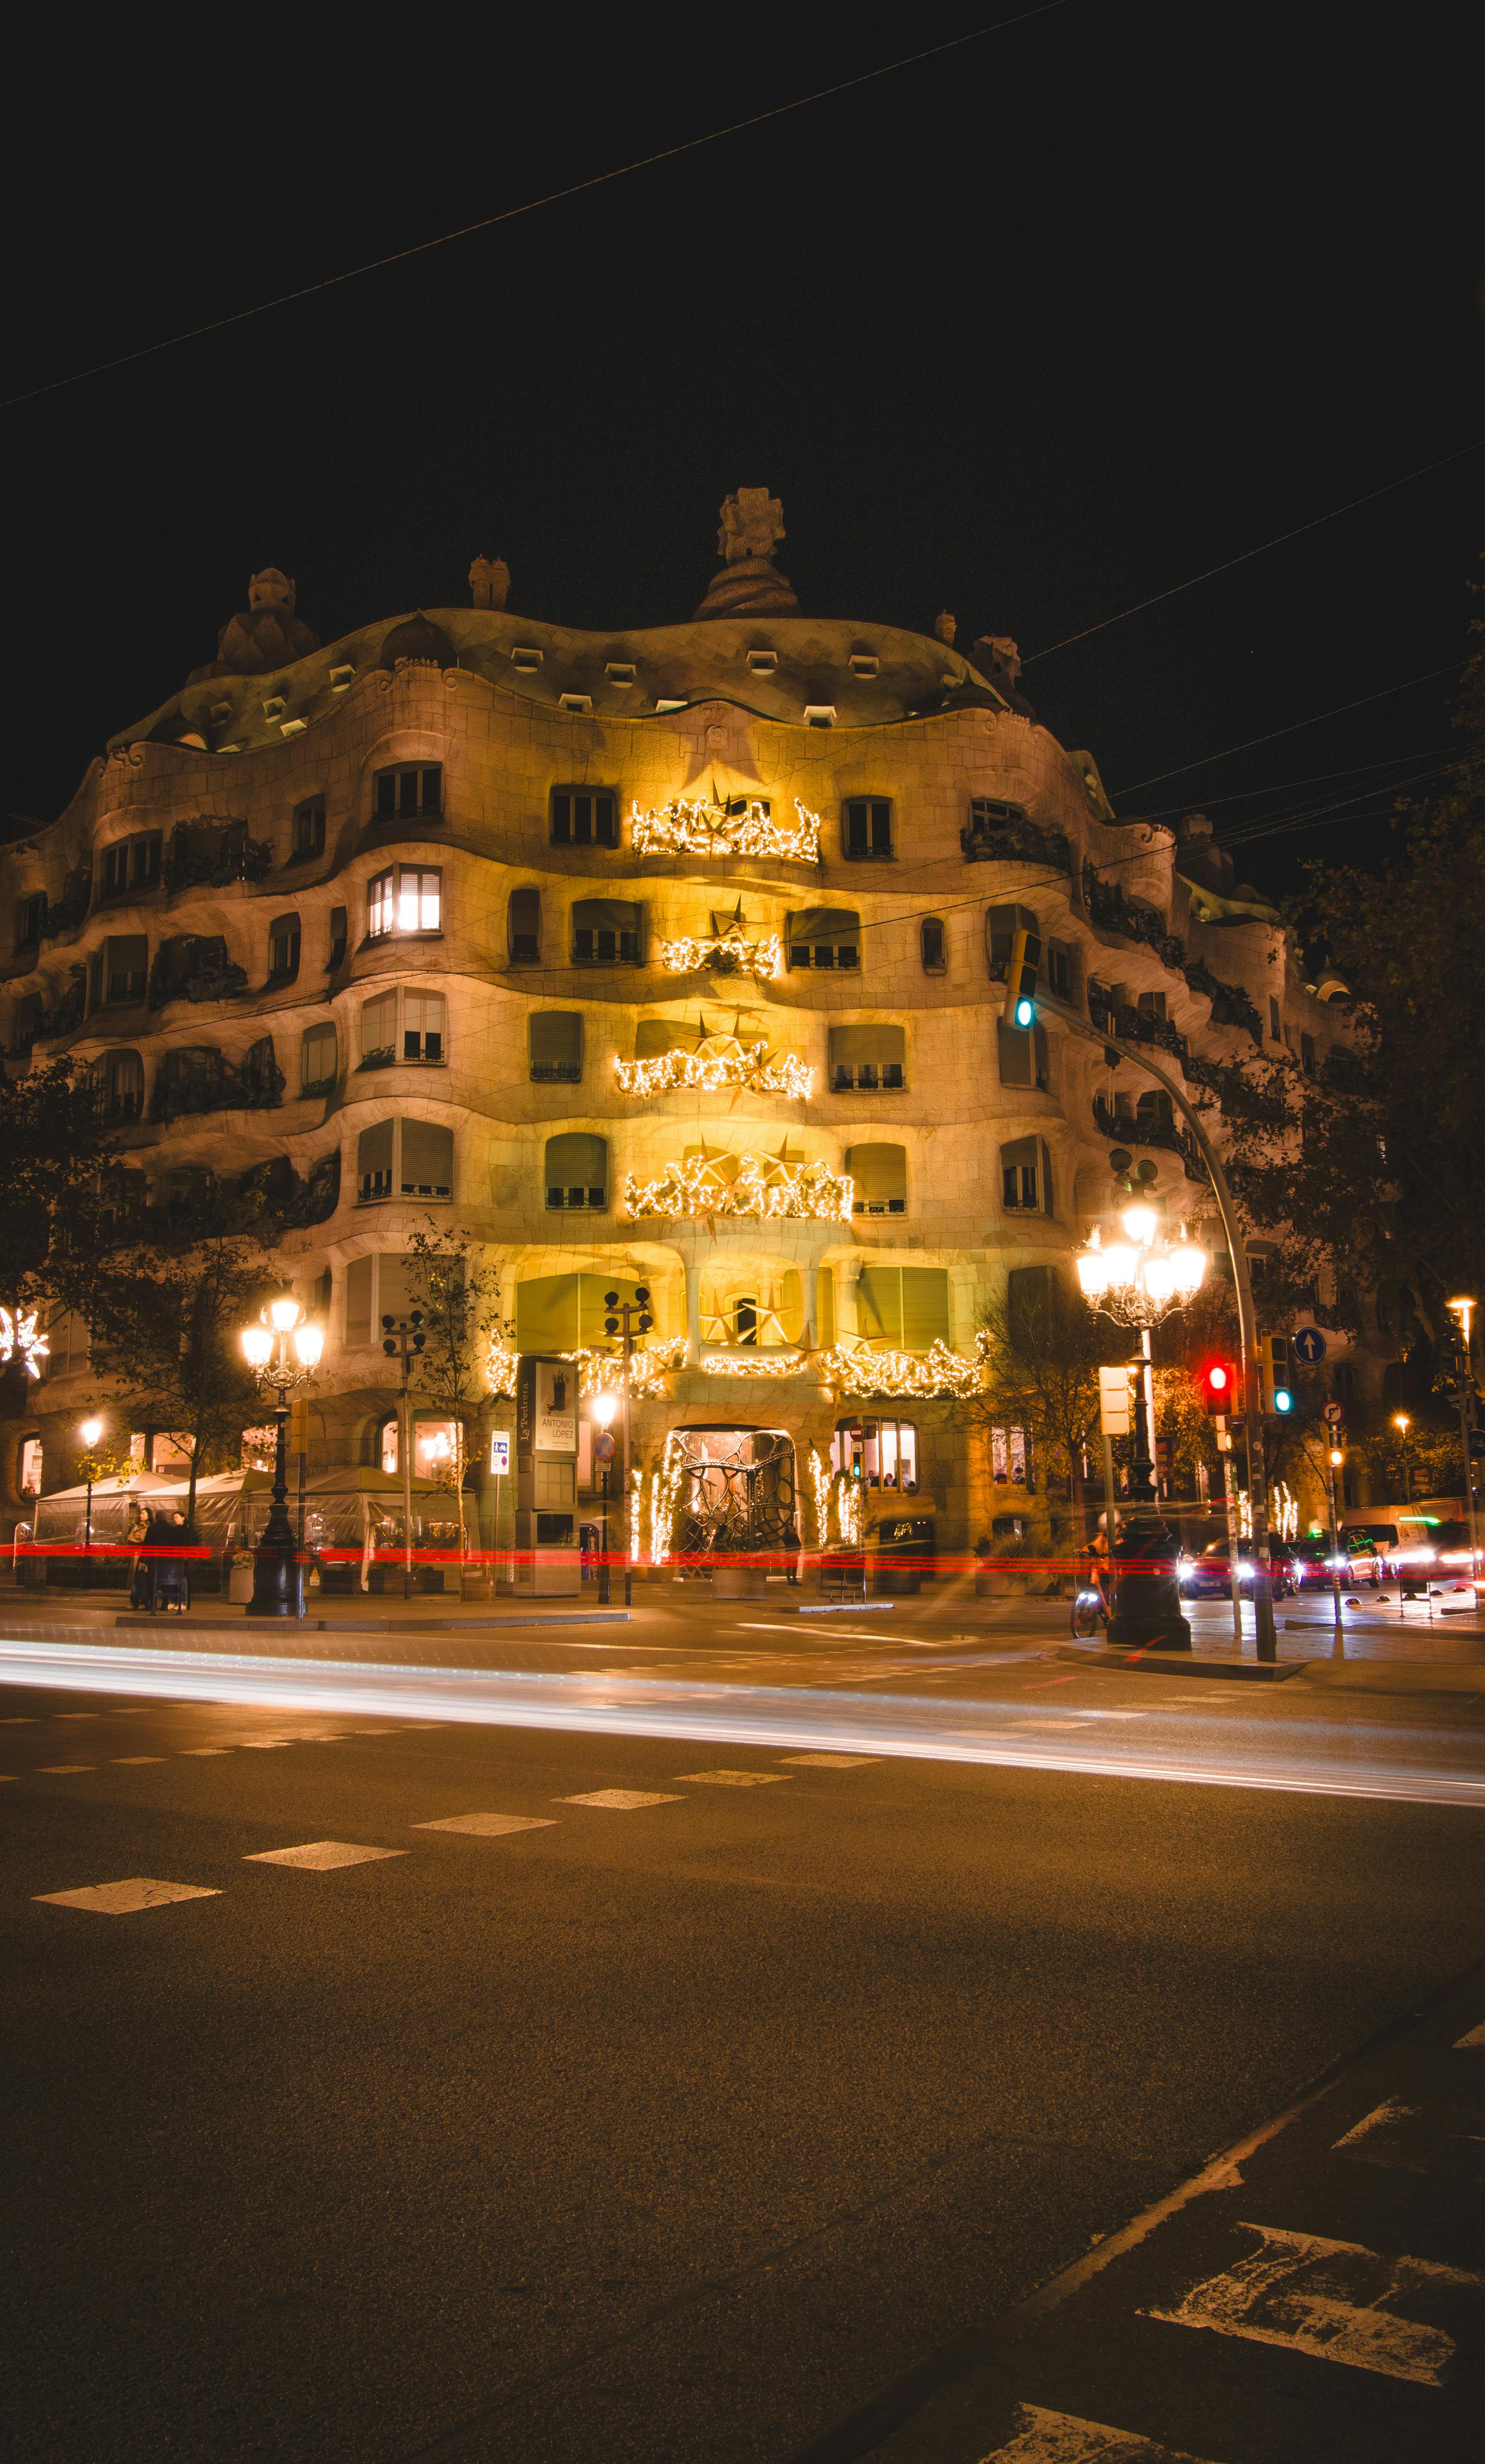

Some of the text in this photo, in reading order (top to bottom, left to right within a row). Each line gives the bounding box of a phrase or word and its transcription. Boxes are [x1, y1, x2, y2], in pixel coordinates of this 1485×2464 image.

[520, 1382, 529, 1441] La Pedrera
[542, 1419, 574, 1429] ANTONIO
[553, 1428, 574, 1438] LÓPEZ
